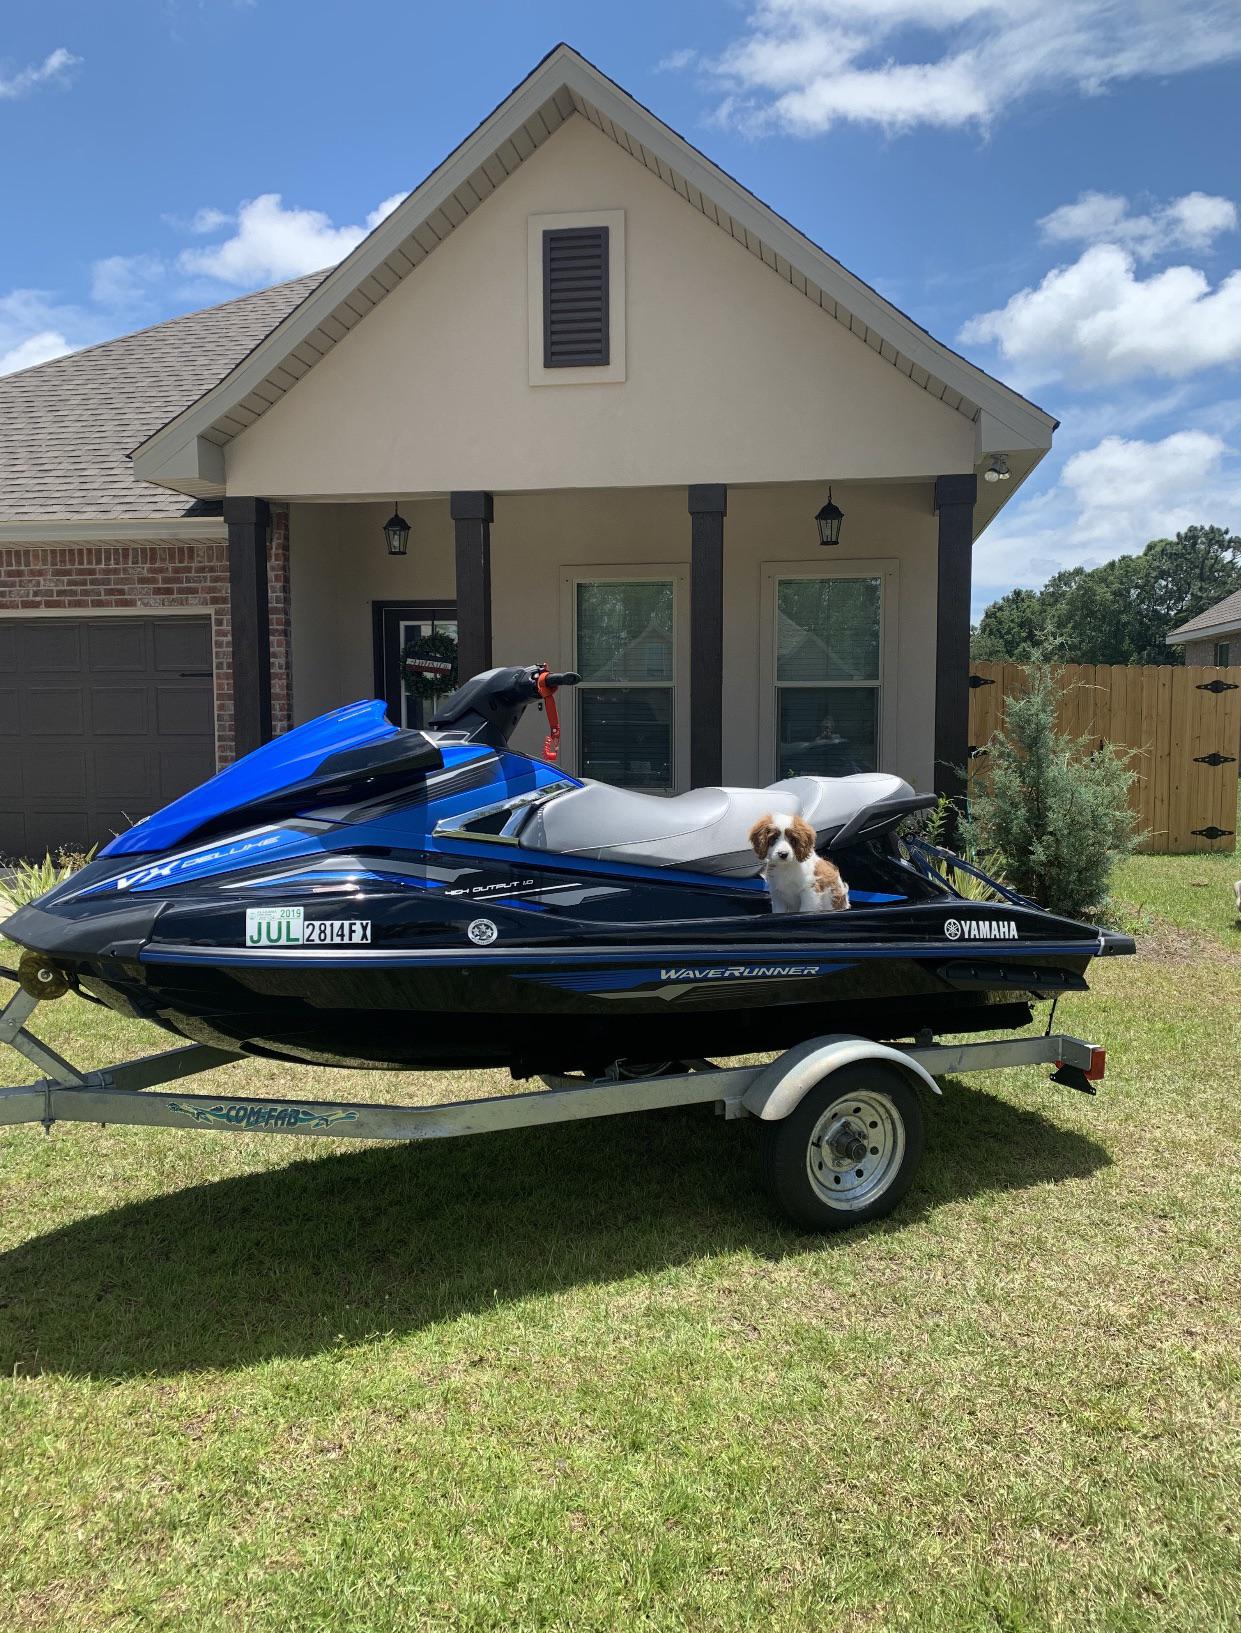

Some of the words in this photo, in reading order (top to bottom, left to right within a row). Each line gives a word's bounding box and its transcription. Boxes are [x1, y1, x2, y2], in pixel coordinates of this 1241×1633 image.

[116, 860, 181, 890] VX
[181, 835, 281, 869] DELUXE
[472, 881, 520, 893] OUTPUT
[280, 909, 302, 918] 2019
[249, 920, 300, 944] JUL
[305, 922, 370, 943] 2814FX
[960, 920, 1019, 939] YAMAHA
[660, 966, 820, 980] WAVERUNNER
